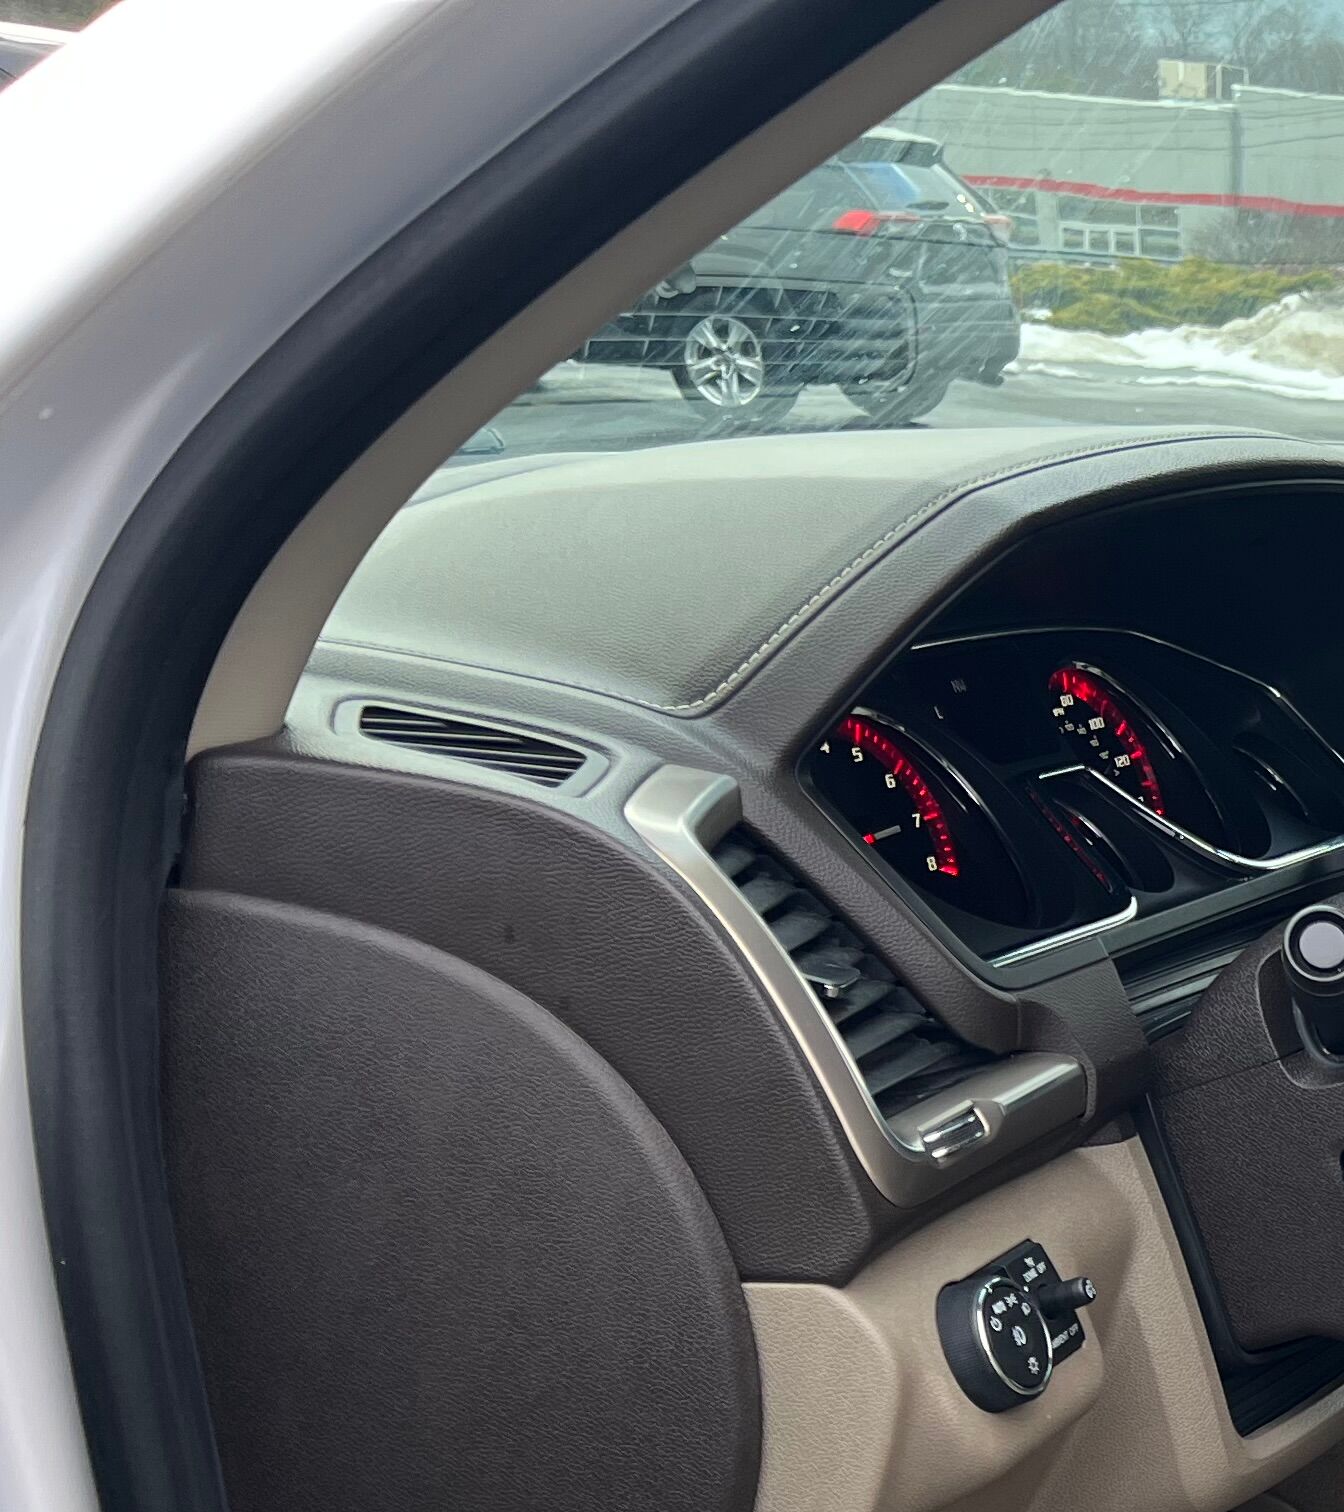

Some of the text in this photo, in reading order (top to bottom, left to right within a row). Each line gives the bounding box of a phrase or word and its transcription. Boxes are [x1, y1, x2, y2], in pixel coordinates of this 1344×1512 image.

[1088, 717, 1105, 731] 100
[851, 747, 864, 763] 5
[1114, 754, 1131, 768] 120
[884, 773, 896, 789] 6
[911, 812, 921, 829] 7
[926, 855, 938, 872] 8
